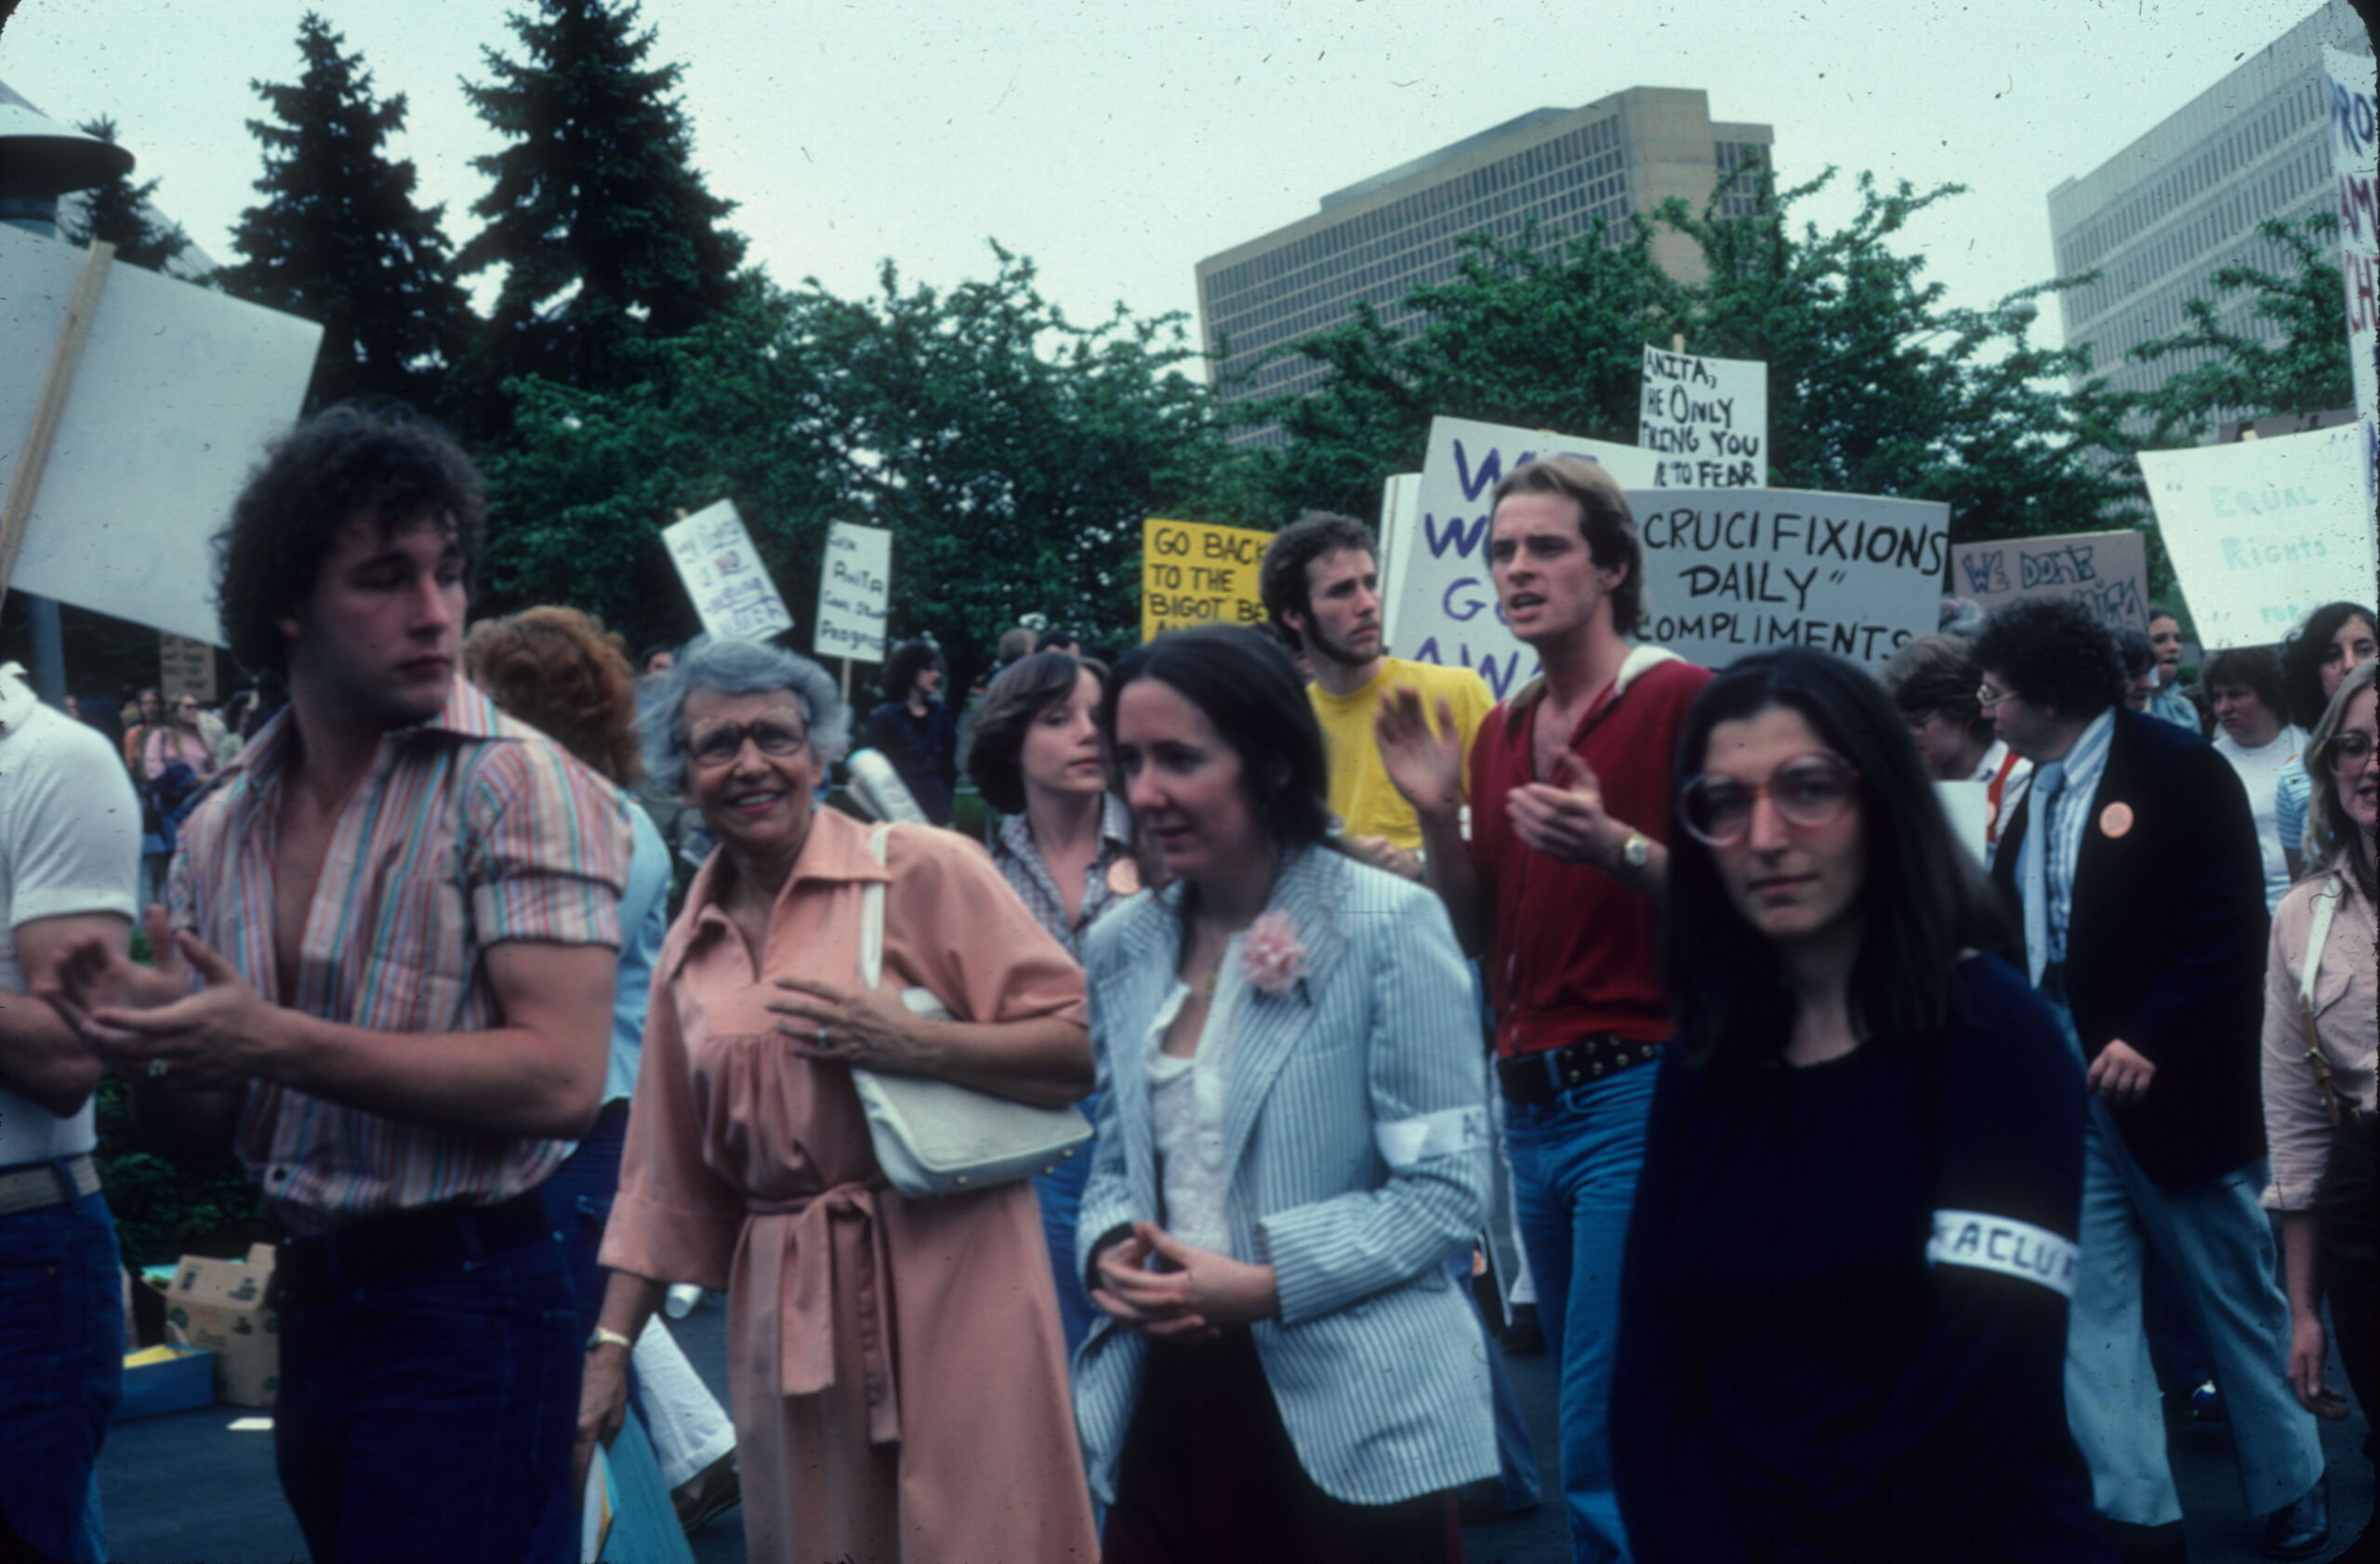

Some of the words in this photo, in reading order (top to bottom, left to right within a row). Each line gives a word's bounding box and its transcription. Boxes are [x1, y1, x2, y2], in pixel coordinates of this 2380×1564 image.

[1670, 383, 1734, 431] ONLY
[1710, 430, 1759, 457] YOU
[1697, 460, 1758, 488] FEAR
[1154, 527, 1190, 557] GO
[1644, 508, 1950, 576] CRUCIFIXIONS
[1150, 563, 1182, 590] TO
[1189, 565, 1236, 592] THE
[1954, 1221, 2059, 1276] ACLU
